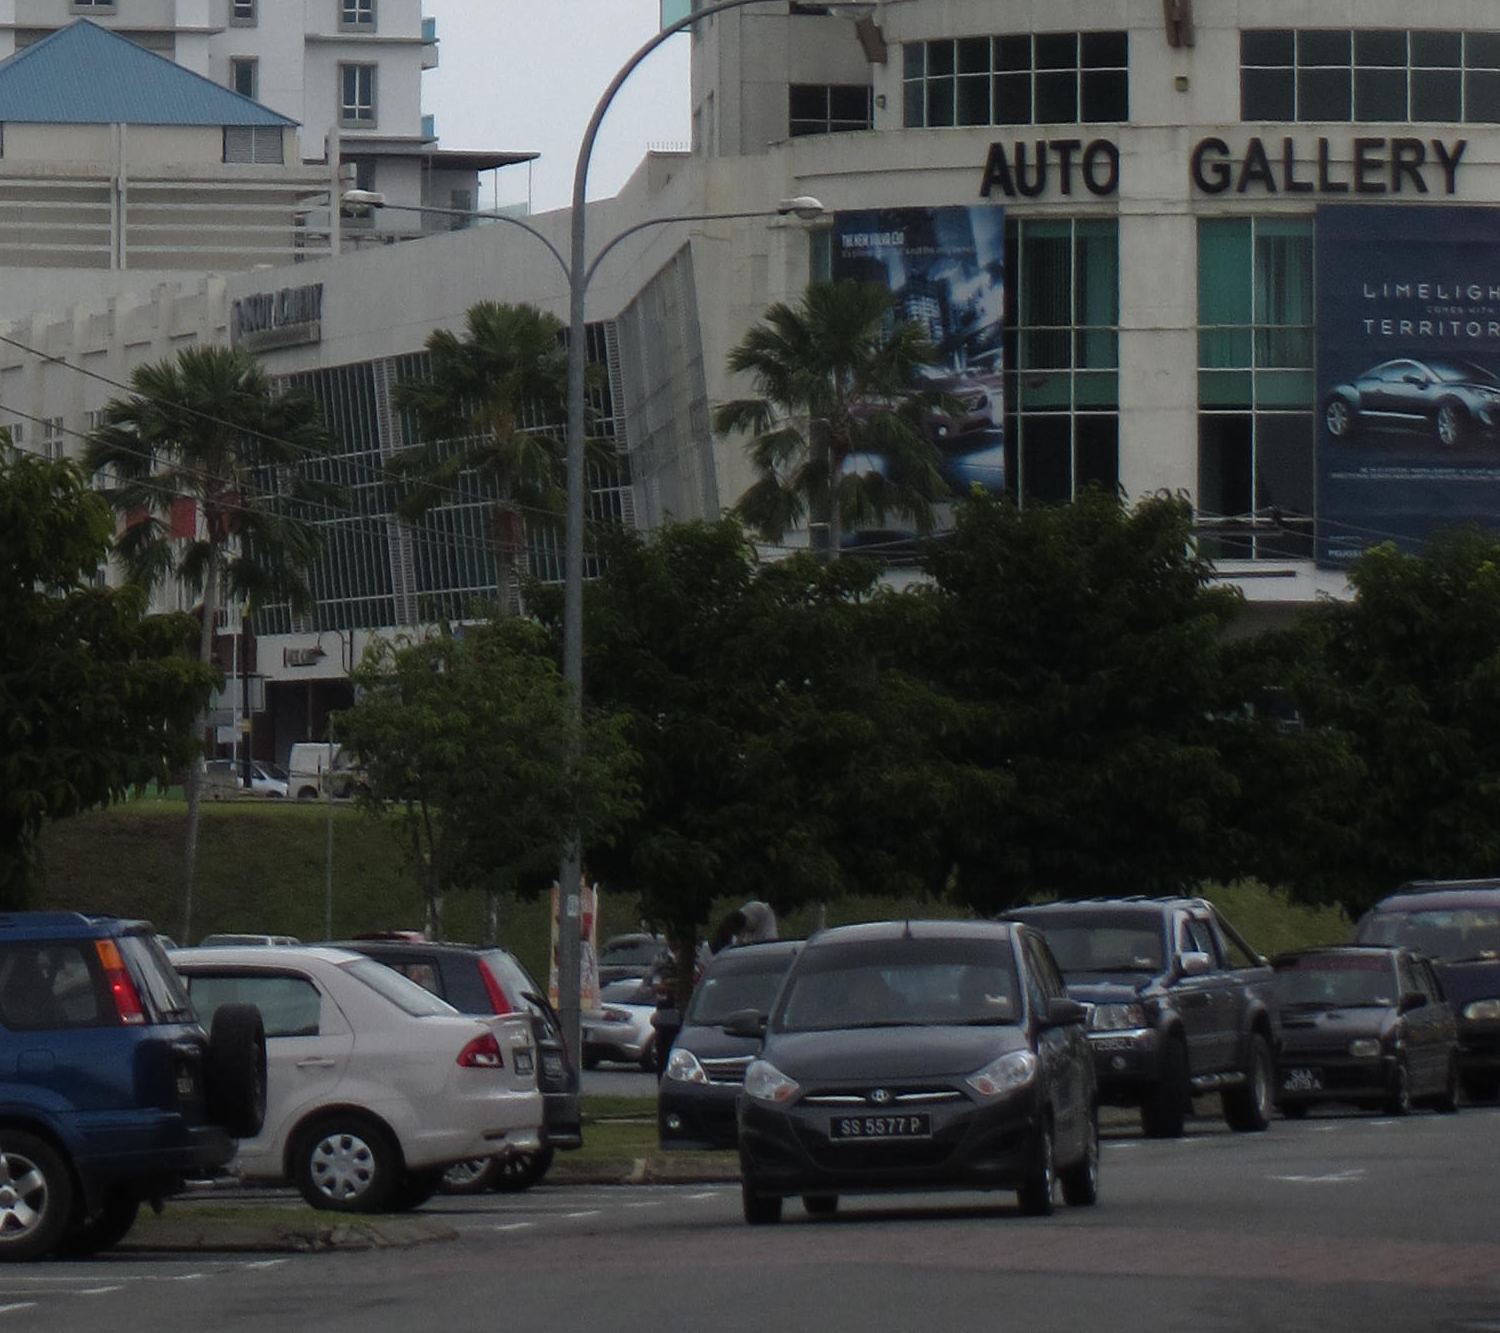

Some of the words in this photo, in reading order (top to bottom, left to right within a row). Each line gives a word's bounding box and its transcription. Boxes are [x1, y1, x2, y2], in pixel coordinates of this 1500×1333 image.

[980, 138, 1120, 198] AUTO
[1191, 136, 1467, 195] GALLERY
[1363, 283, 1500, 301] LIMELIGH
[1363, 318, 1500, 337] TERRITOR
[841, 1119, 861, 1135] SS
[865, 1117, 906, 1135] 5577
[910, 1116, 921, 1134] P
